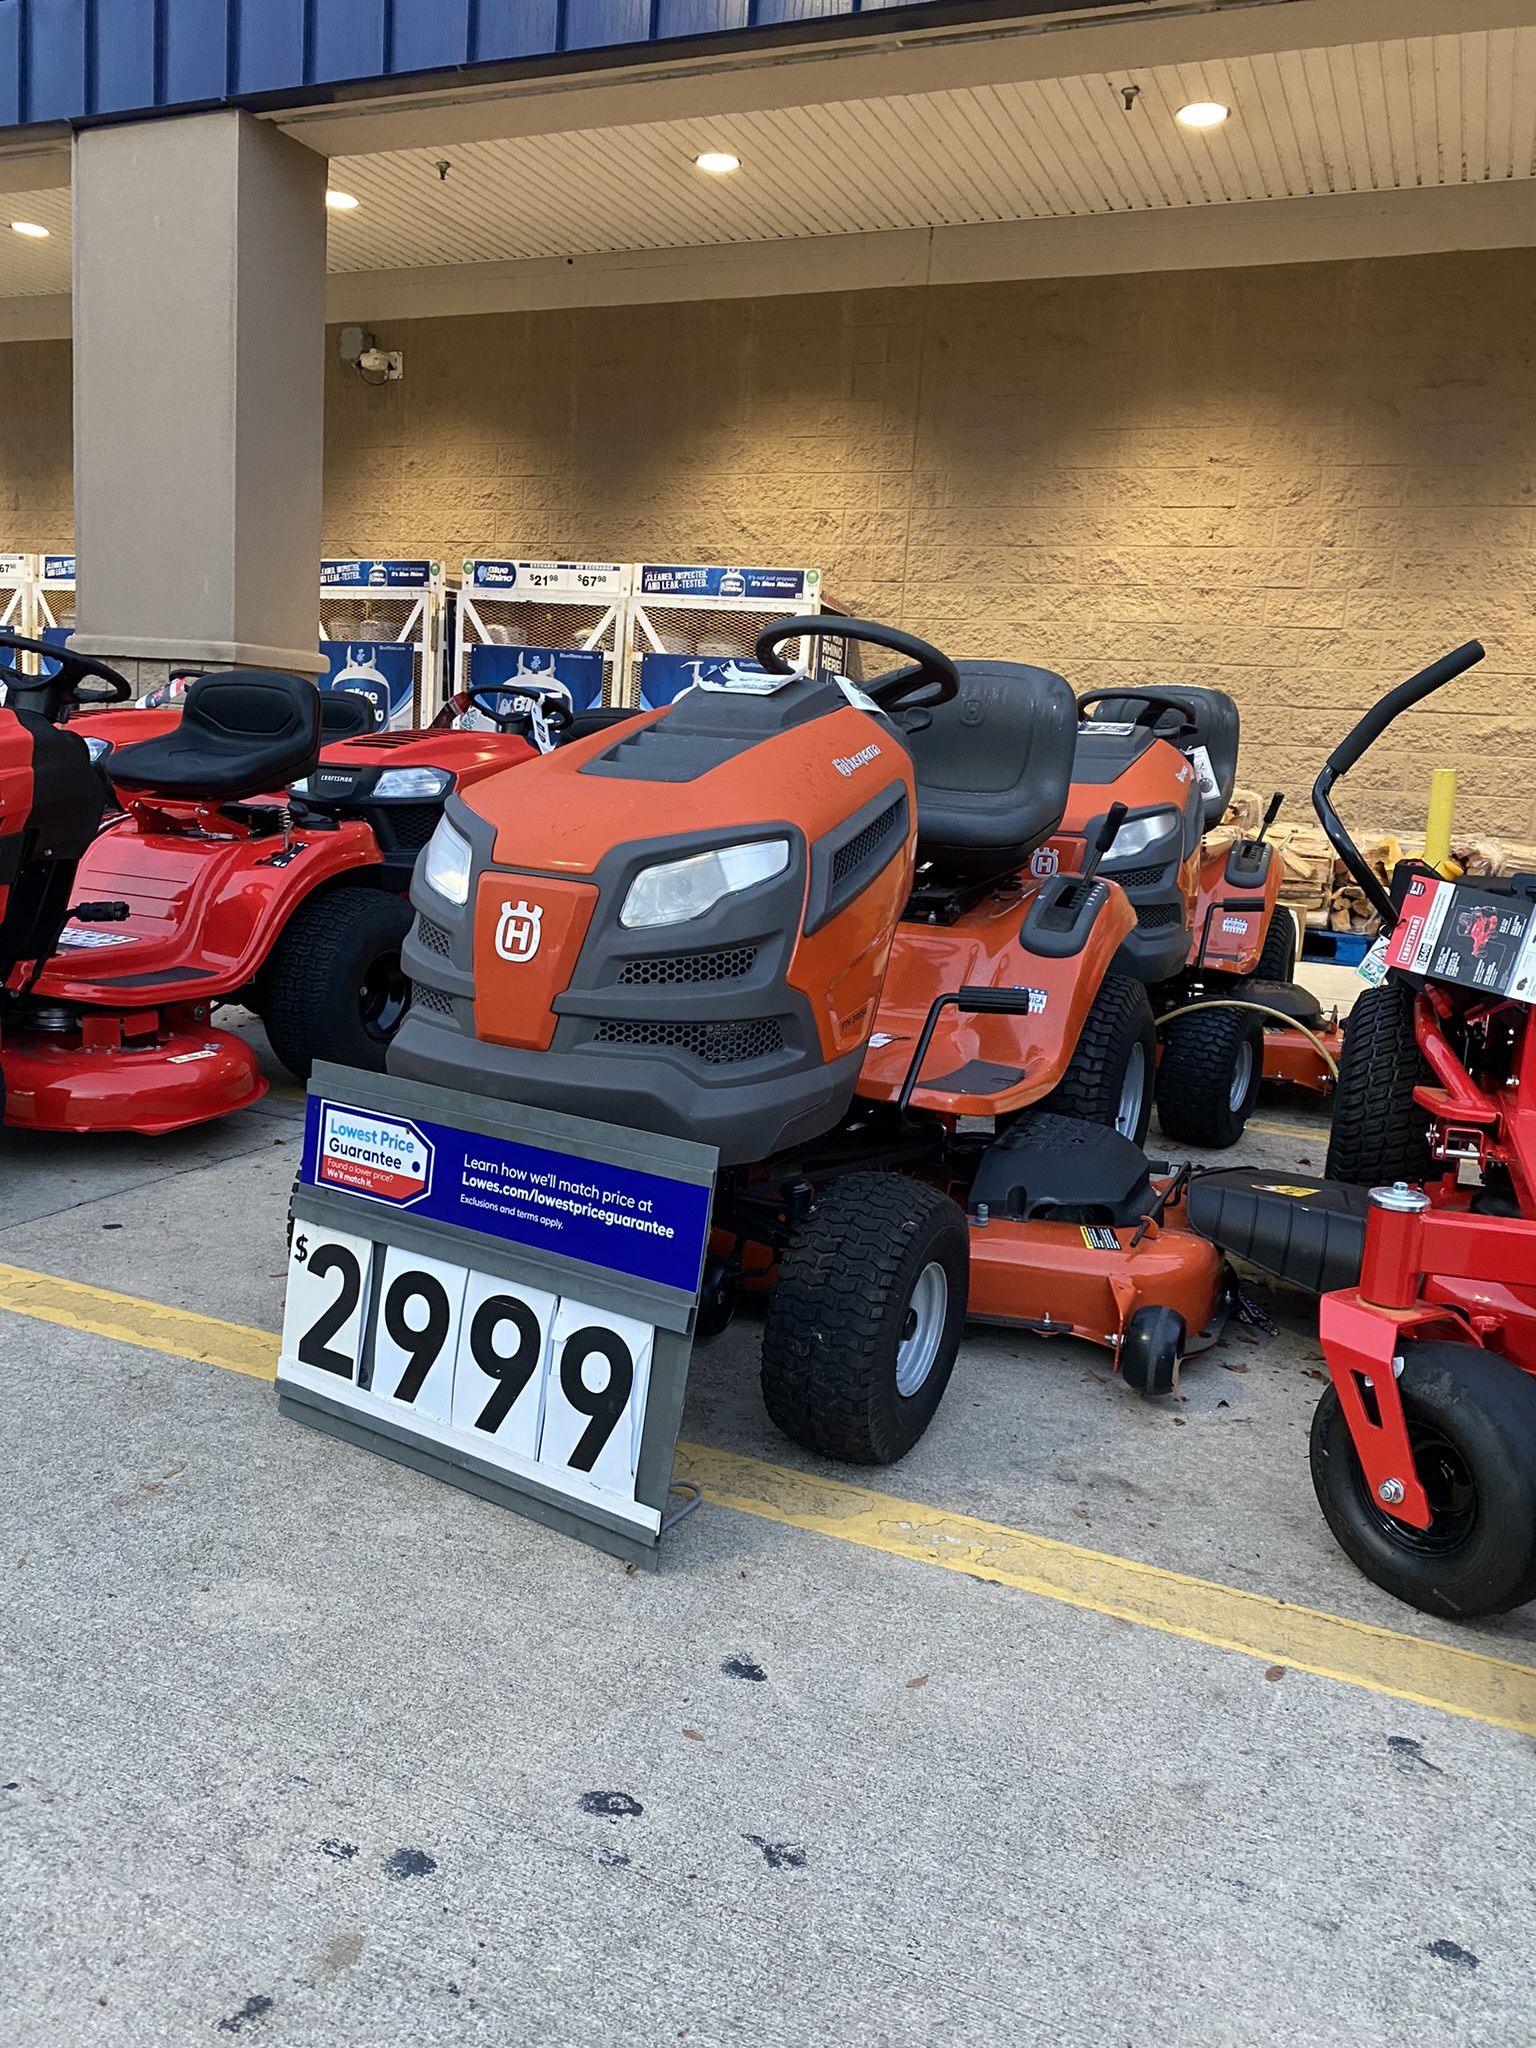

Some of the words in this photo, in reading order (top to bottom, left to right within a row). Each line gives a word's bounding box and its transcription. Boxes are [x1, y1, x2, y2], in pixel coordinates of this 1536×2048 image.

[485, 574, 513, 583] Rhino
[488, 566, 508, 575] Blue
[321, 774, 353, 783] CRAFTSMAN
[1401, 918, 1421, 962] CRAFTSMAN
[330, 1118, 377, 1145] Lowest
[380, 1131, 415, 1154] Price
[329, 1137, 402, 1170] Guarantee
[327, 1157, 348, 1173] Found
[355, 1166, 373, 1178] lower
[373, 1173, 394, 1185] price?
[327, 1168, 343, 1181] We'll
[344, 1174, 367, 1185] match
[365, 1177, 374, 1188] it.
[464, 1153, 498, 1175] Learn
[501, 1162, 528, 1182] how
[530, 1173, 557, 1189] we'll
[559, 1180, 600, 1200] match
[602, 1190, 636, 1208] price
[638, 1200, 654, 1213] at
[460, 1193, 500, 1212] Exclusions
[500, 1206, 517, 1216] and
[517, 1209, 540, 1222] terms
[540, 1216, 565, 1230] apply.
[462, 1171, 675, 1239] Lowes.com/lowestpriceguarantee
